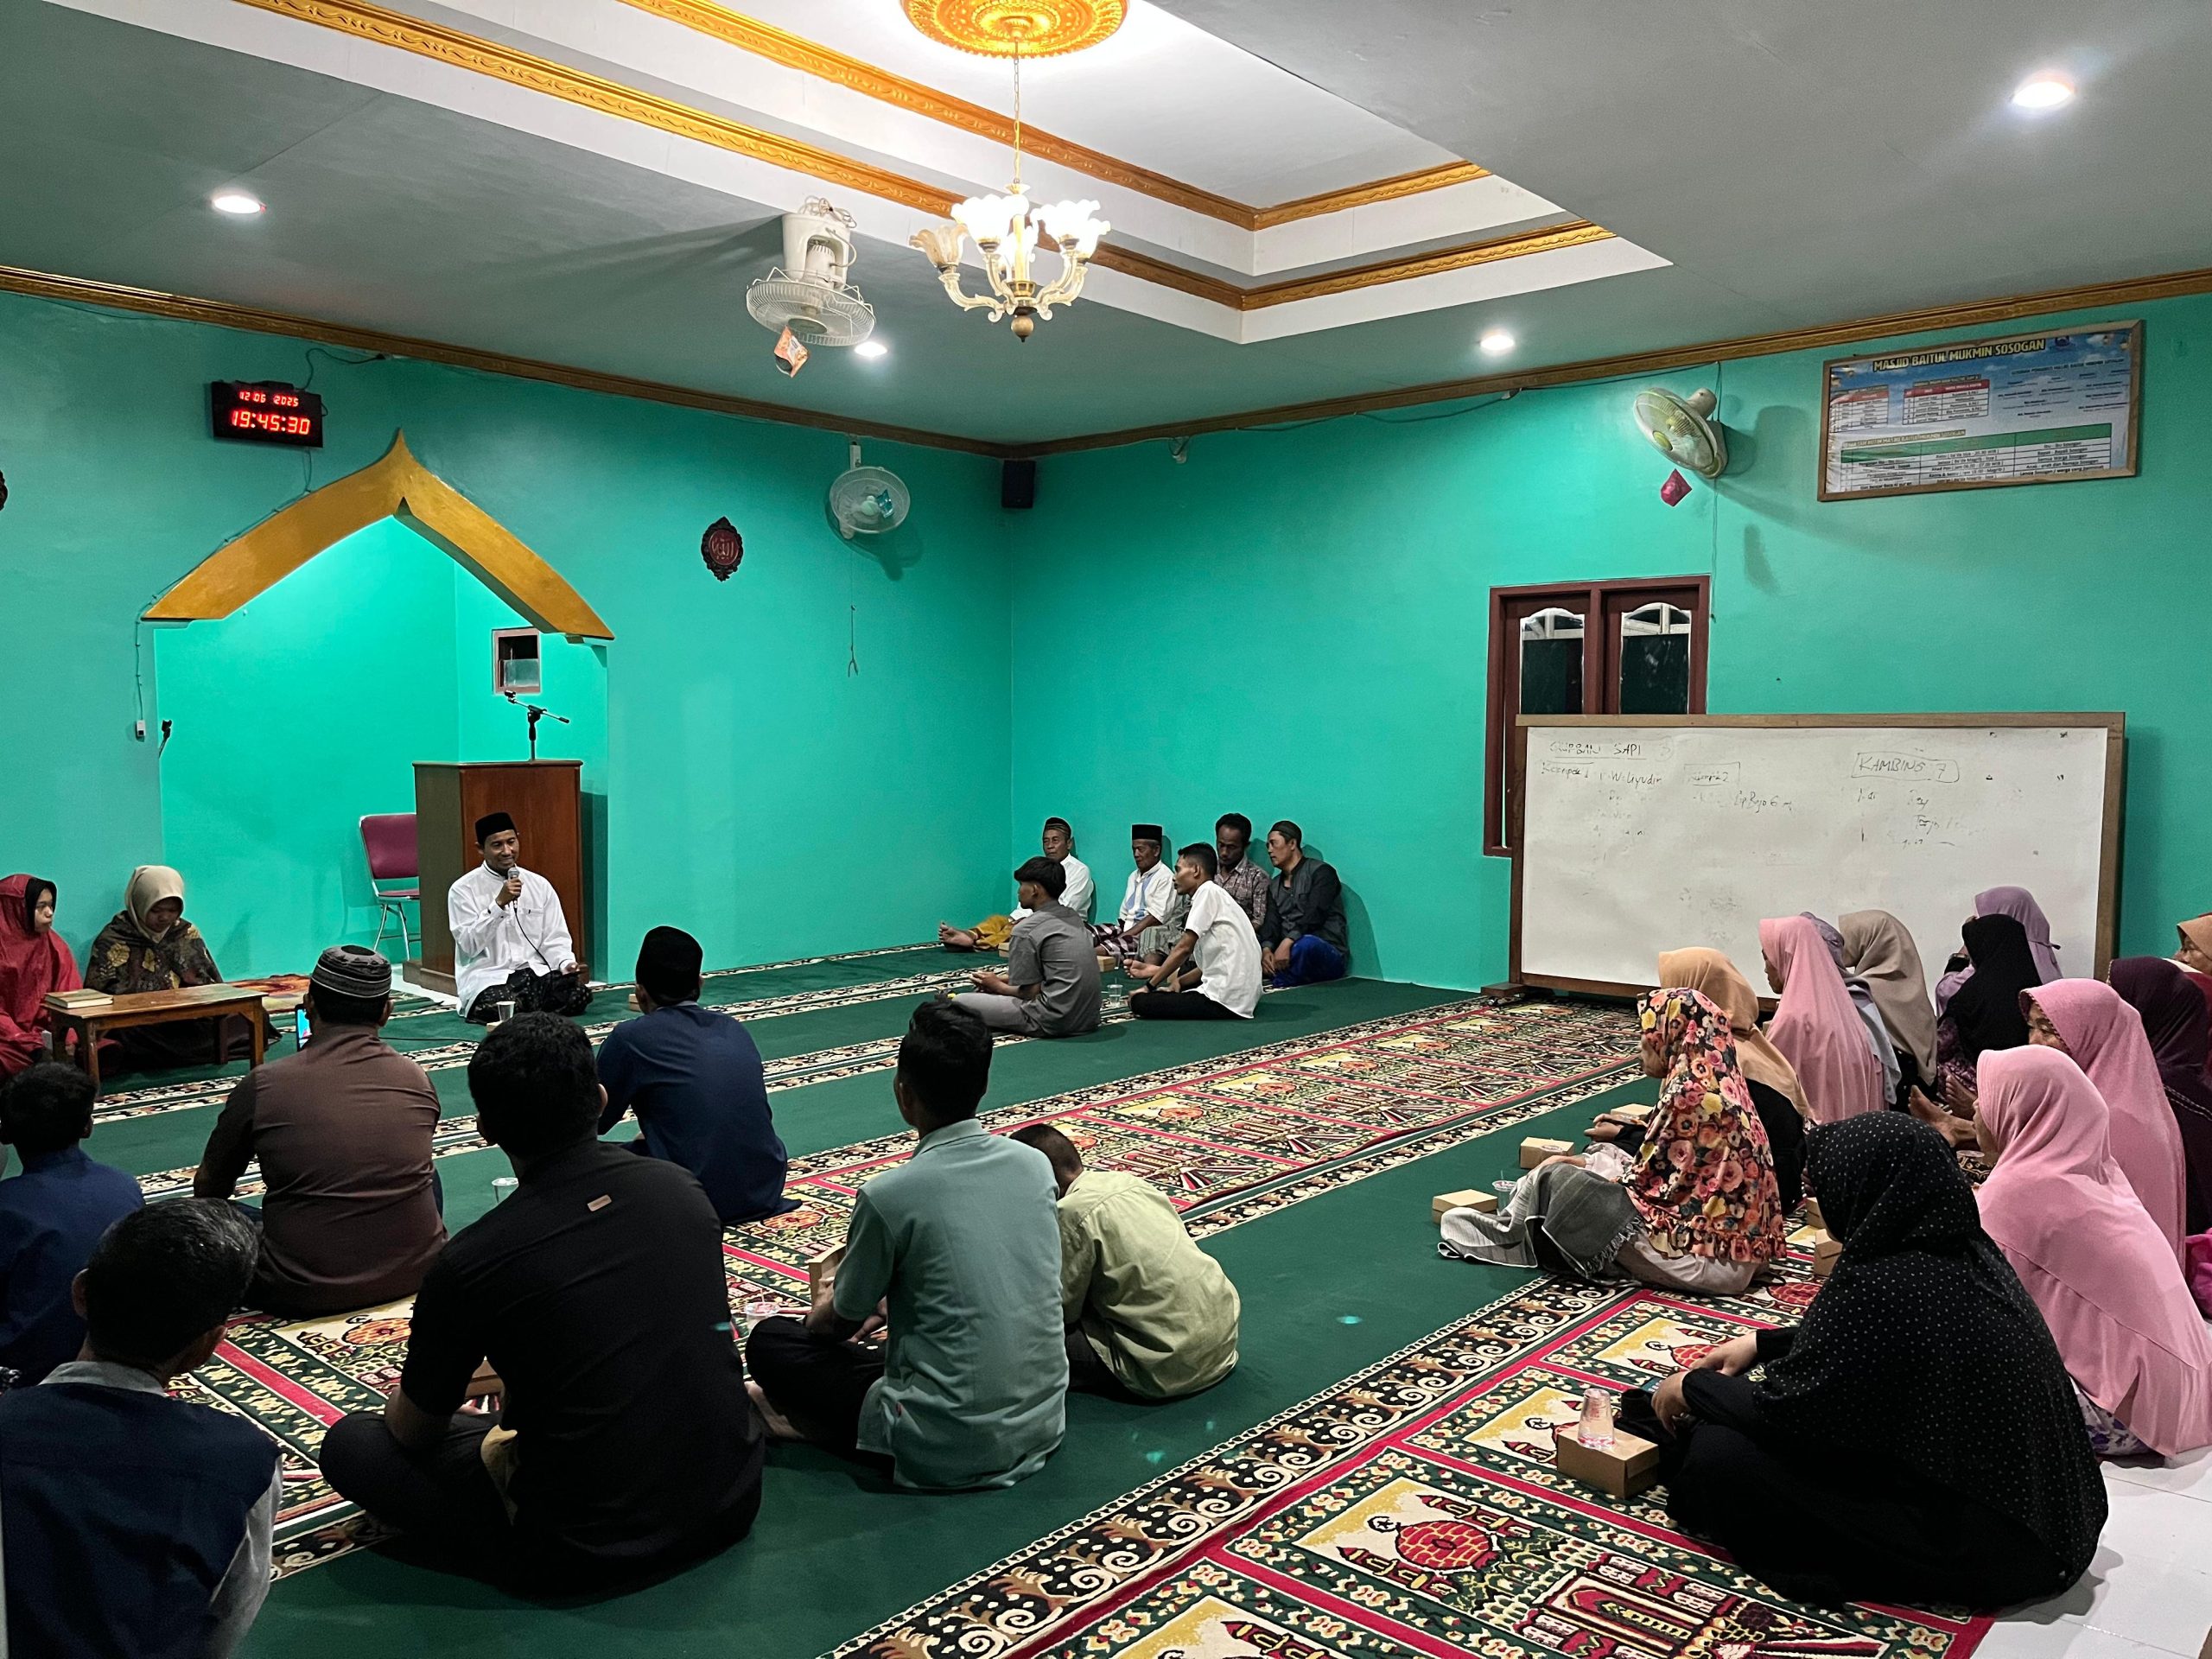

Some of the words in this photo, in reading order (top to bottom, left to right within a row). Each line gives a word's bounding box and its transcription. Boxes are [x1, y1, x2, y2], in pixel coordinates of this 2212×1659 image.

[1873, 358, 1910, 372] MASJID
[1911, 352, 1947, 366] BAITUL
[1949, 346, 1993, 361] MUKMIN
[1995, 339, 2045, 356] SOSOGAN
[232, 410, 311, 435] 19:45:30
